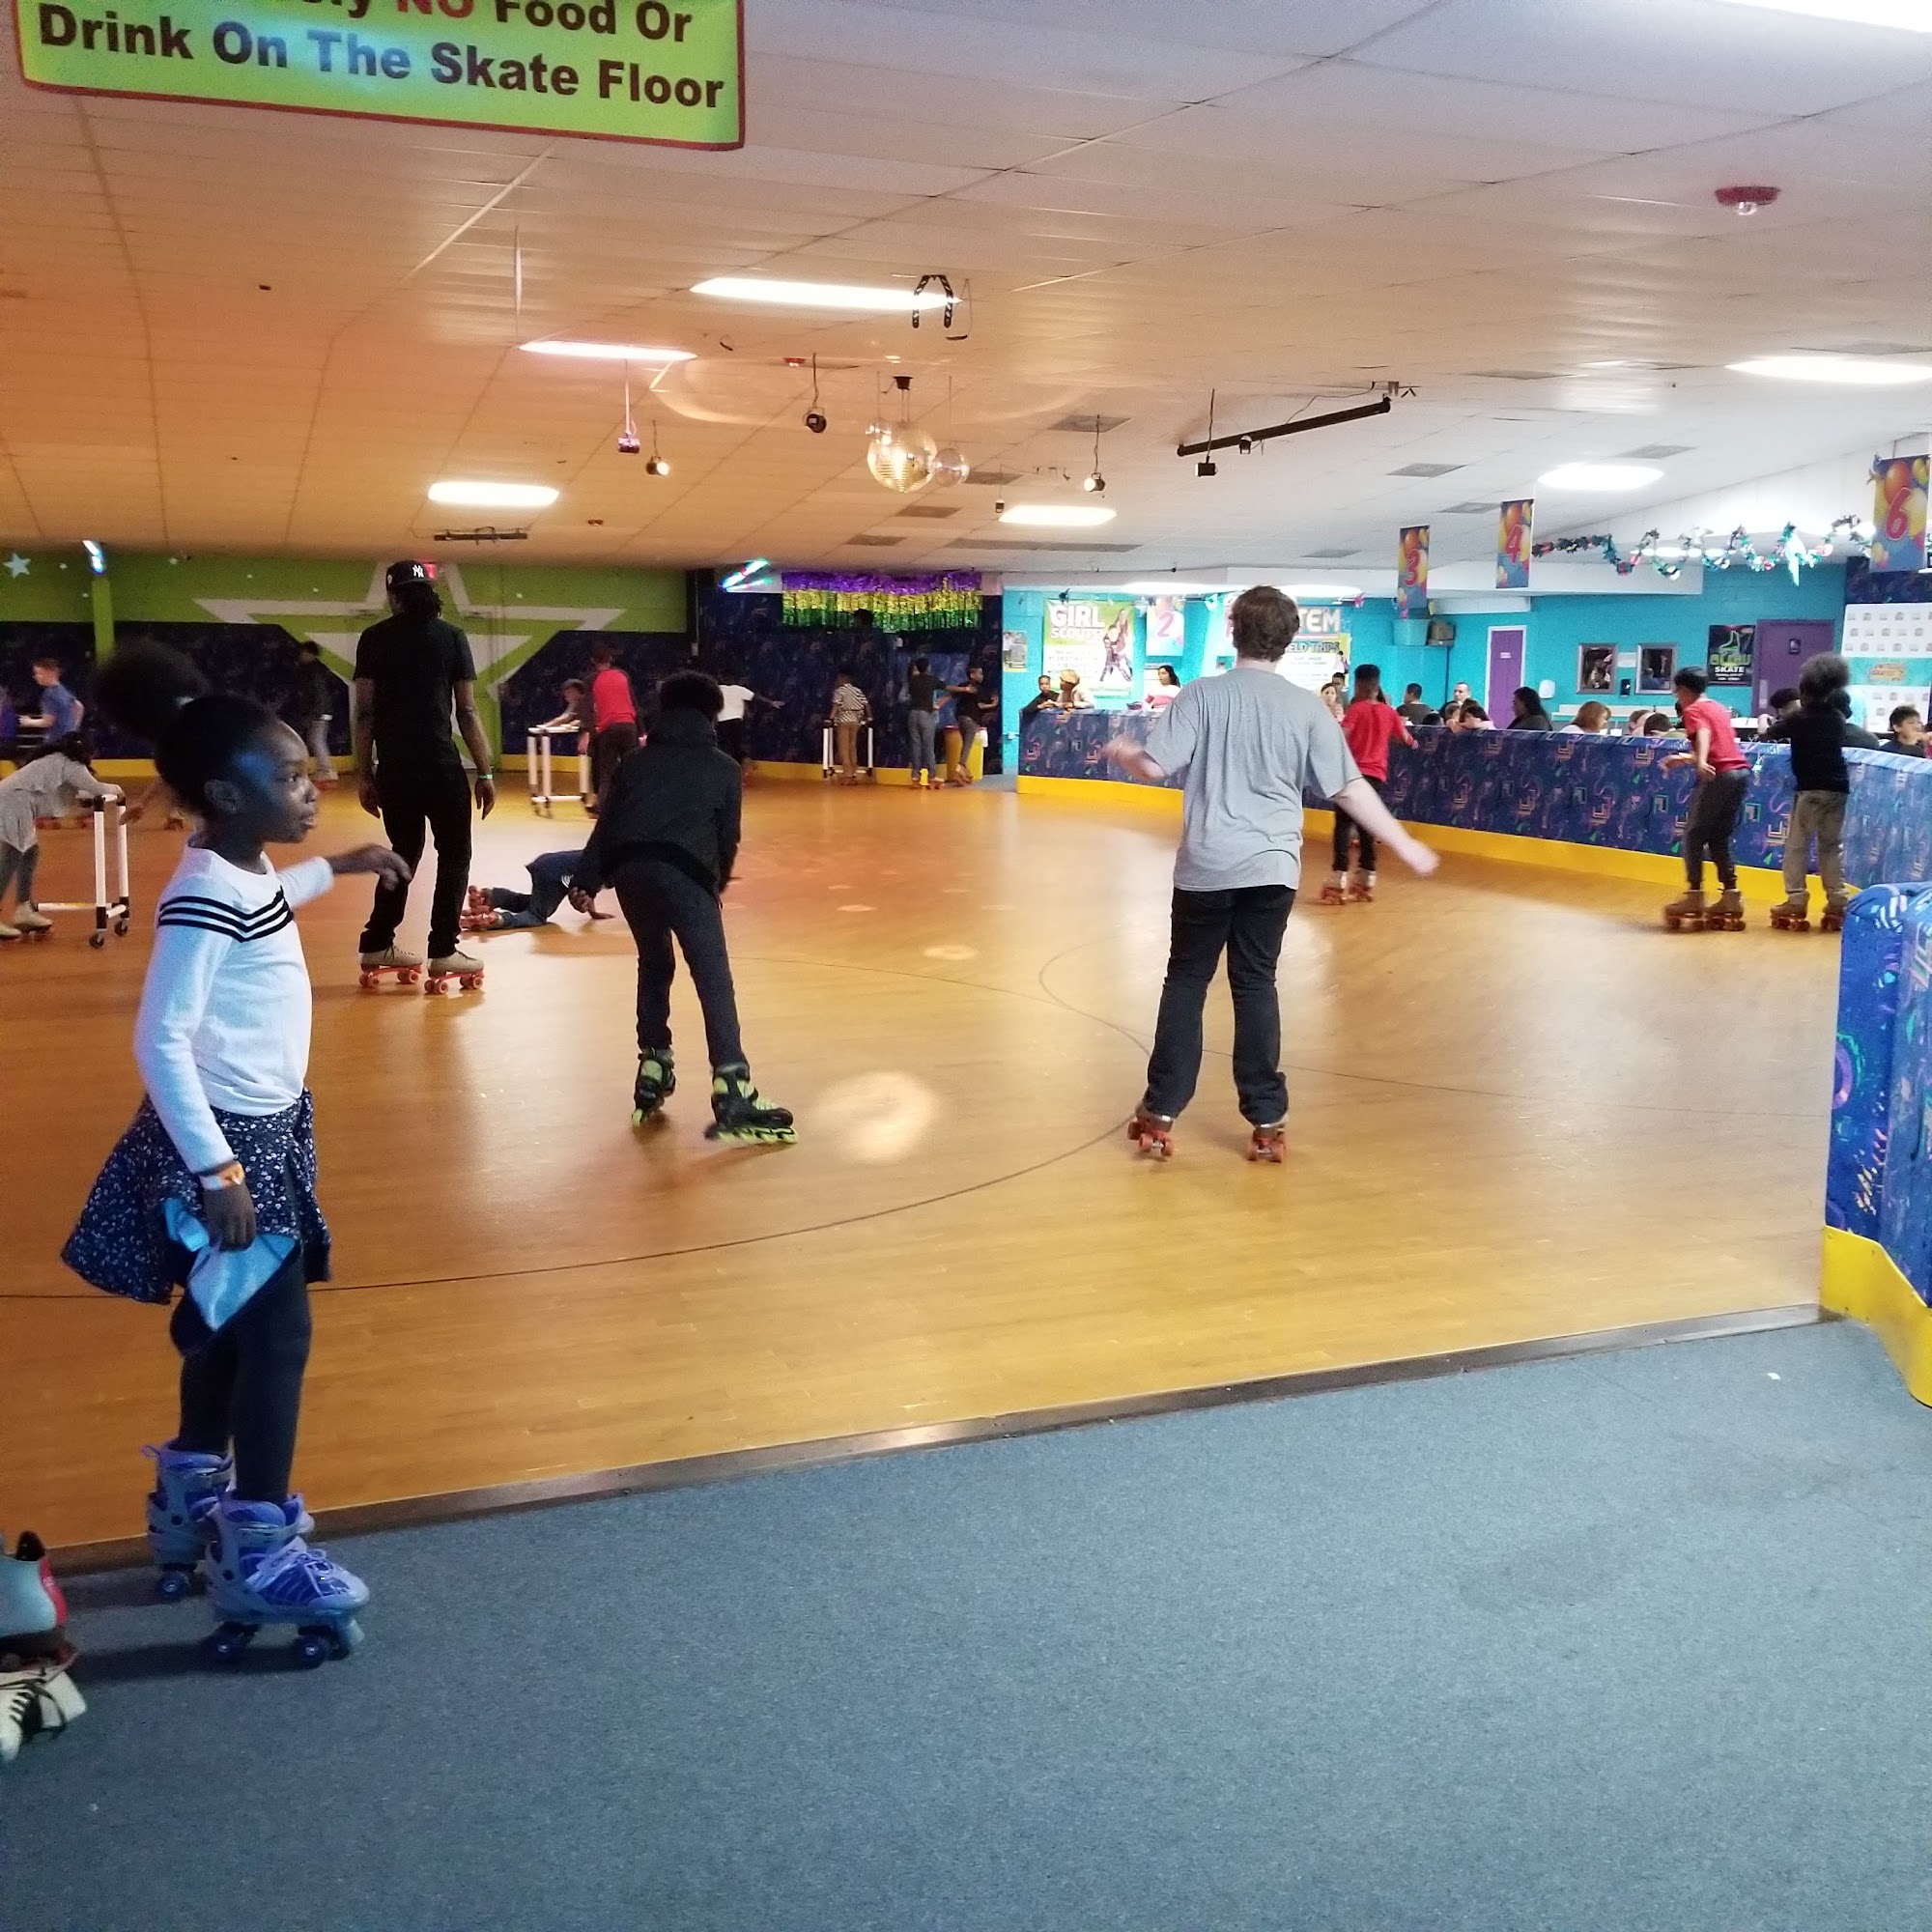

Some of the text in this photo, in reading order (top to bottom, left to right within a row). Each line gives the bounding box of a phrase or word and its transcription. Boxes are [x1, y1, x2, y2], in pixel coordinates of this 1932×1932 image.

[636, 1, 693, 43] Or
[39, 3, 724, 108] Drink On The Skate Floor
[1885, 487, 1912, 541] 6
[1505, 524, 1523, 566] 4
[1404, 548, 1420, 586] 3
[1050, 605, 1106, 628] GIRL
[1156, 611, 1175, 638] 2
[1297, 607, 1342, 633] TEM
[1310, 641, 1341, 653] TRIPS
